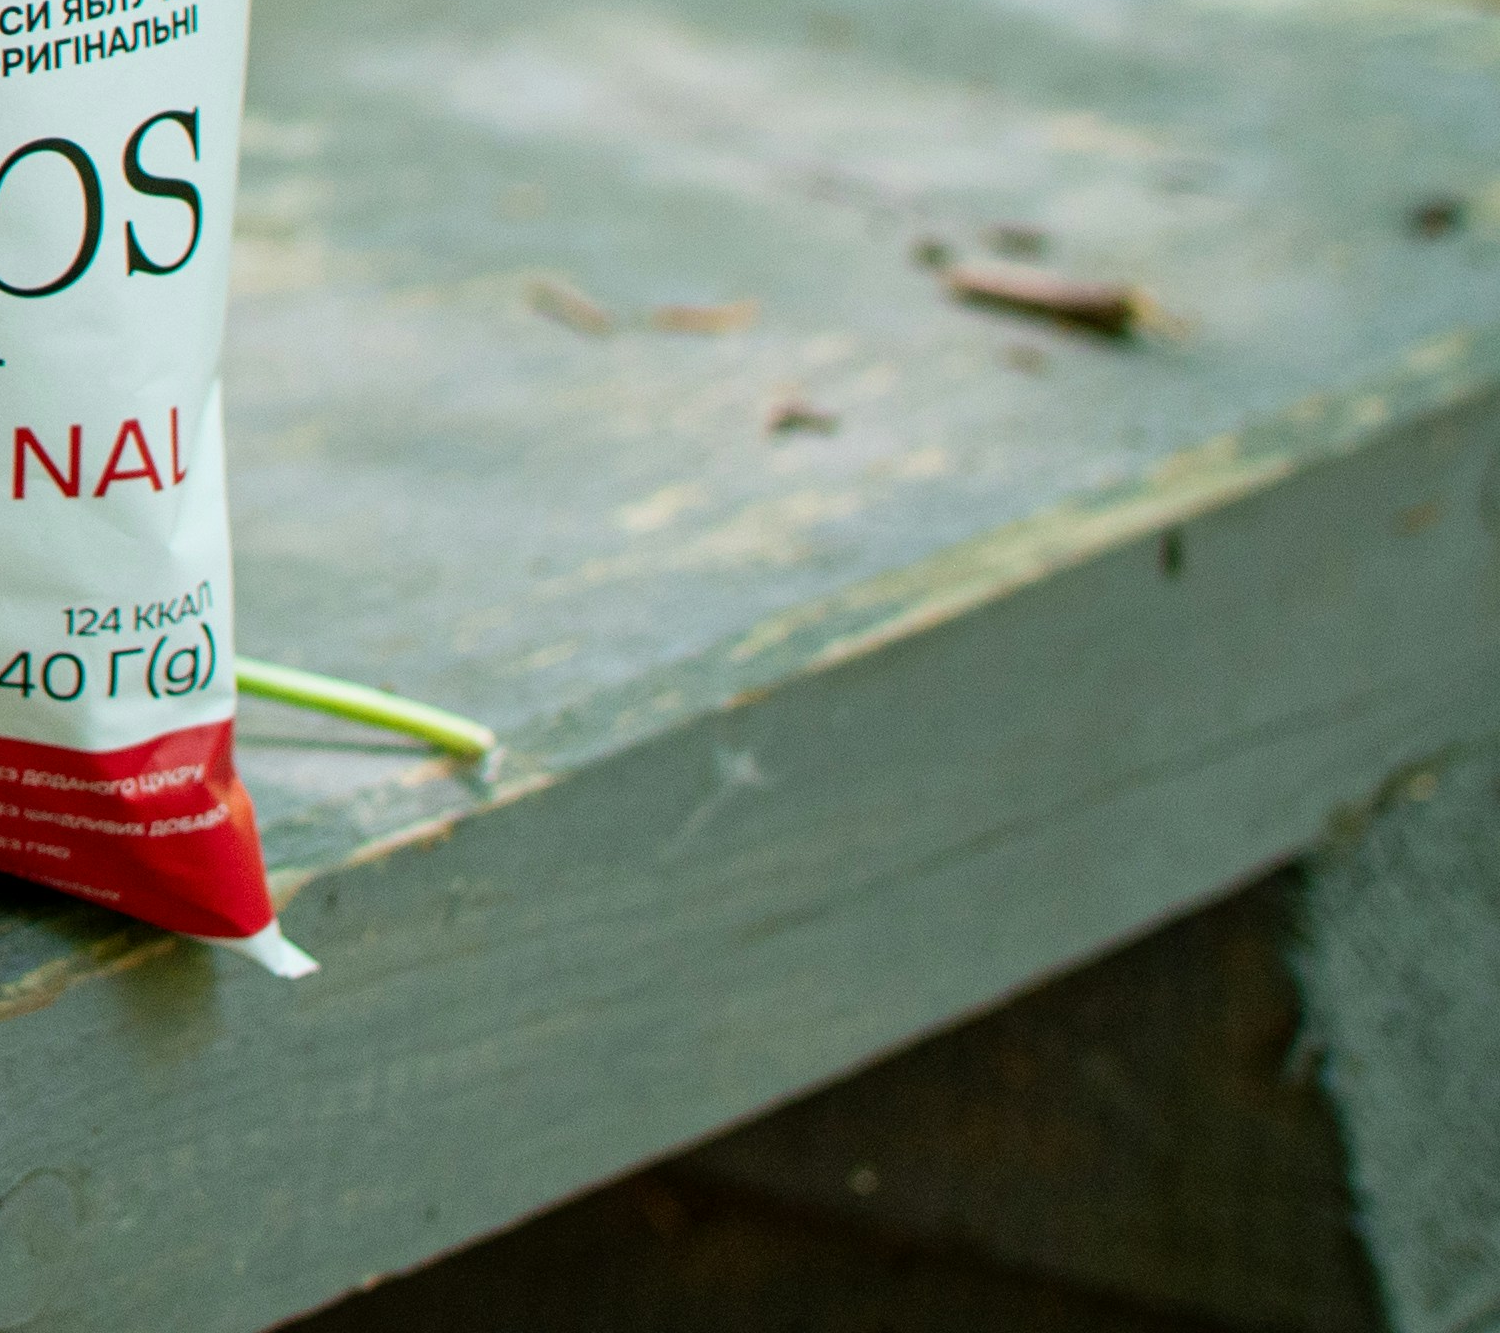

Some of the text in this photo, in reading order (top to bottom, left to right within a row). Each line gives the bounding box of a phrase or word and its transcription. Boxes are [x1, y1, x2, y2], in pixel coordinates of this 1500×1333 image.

[62, 580, 213, 637] 124 ККАЛ
[107, 621, 217, 699] Г(g)
[21, 768, 136, 799] ДОДАНОГО
[148, 802, 230, 838] ДОБАВО
